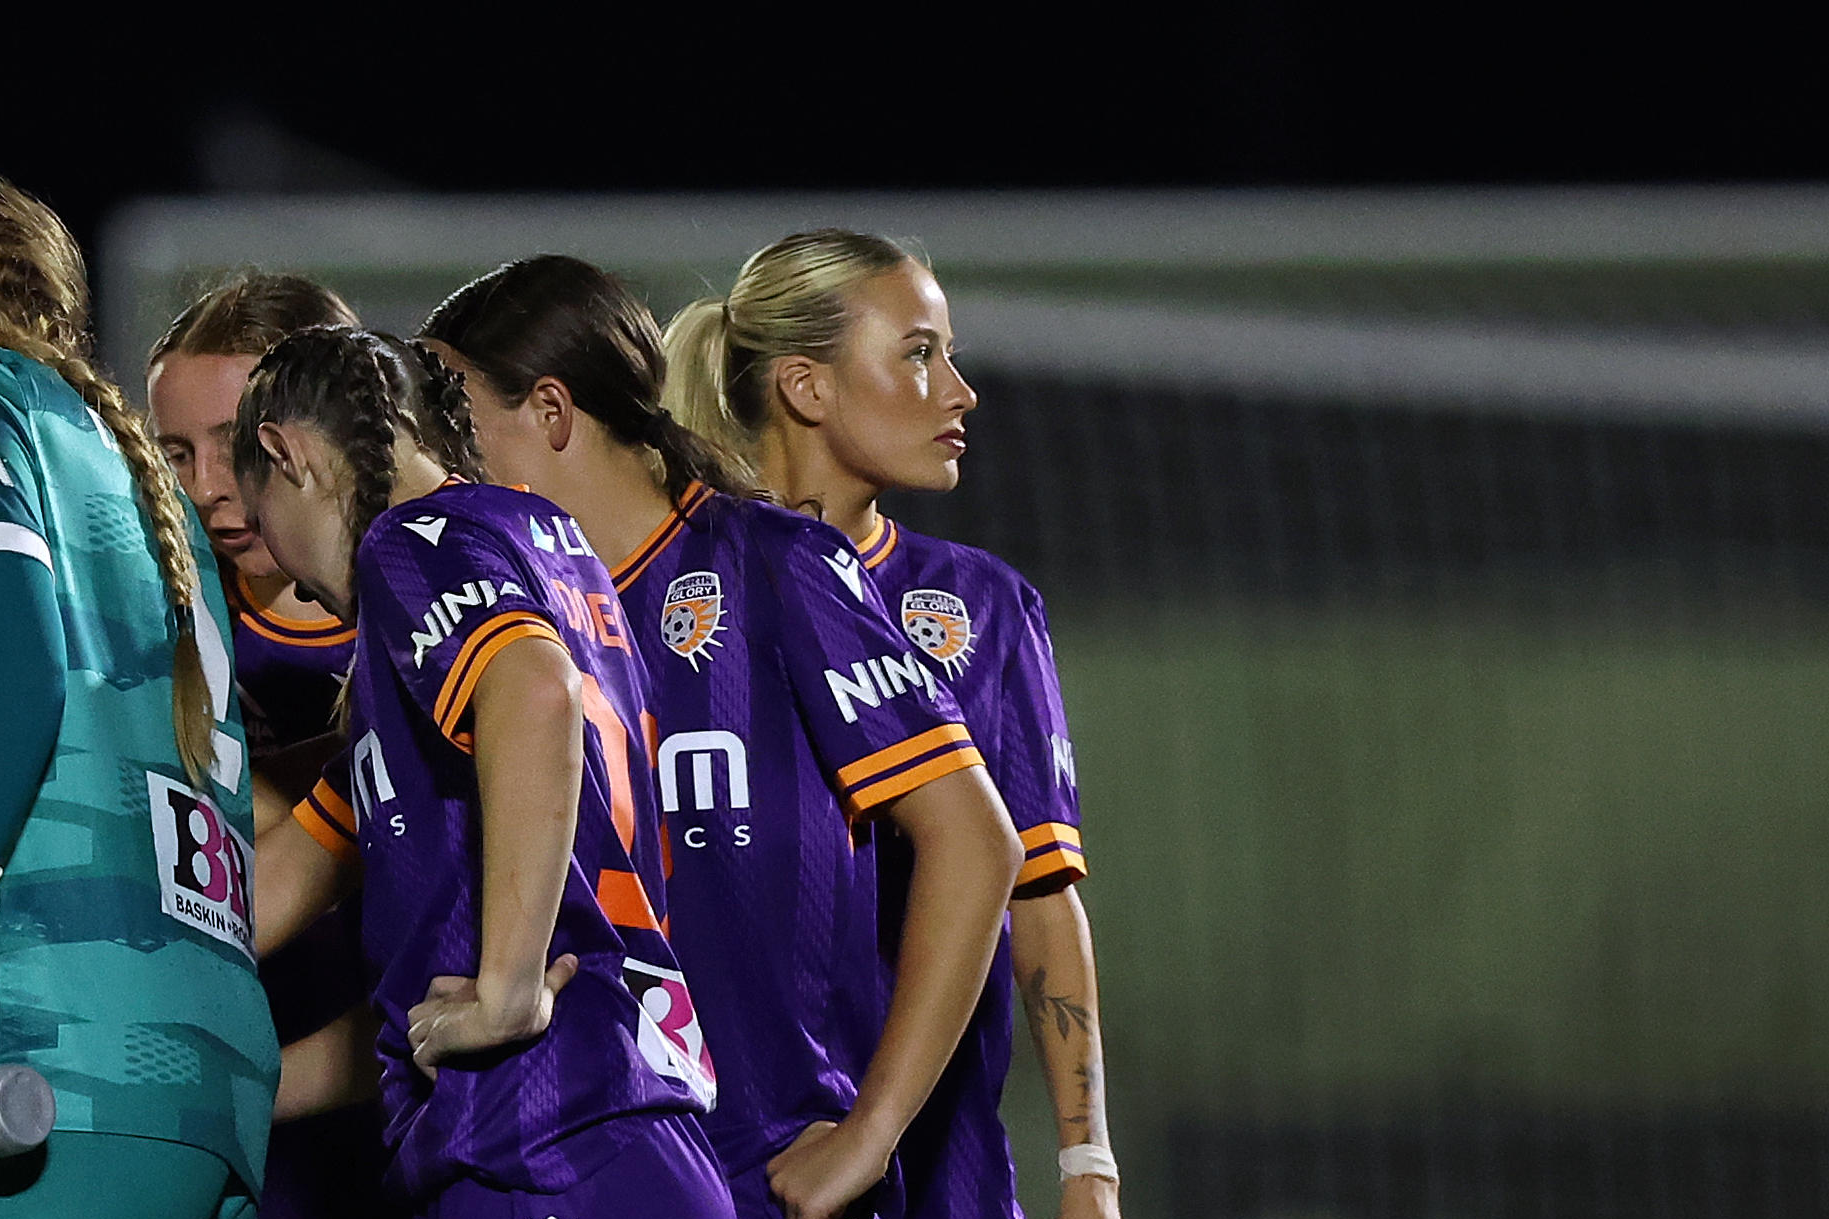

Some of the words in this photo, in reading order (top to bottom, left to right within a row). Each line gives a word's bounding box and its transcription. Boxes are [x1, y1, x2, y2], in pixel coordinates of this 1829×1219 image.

[671, 586, 712, 601] GLORY
[824, 650, 938, 724] NINJ
[176, 893, 226, 933] BASKIN
